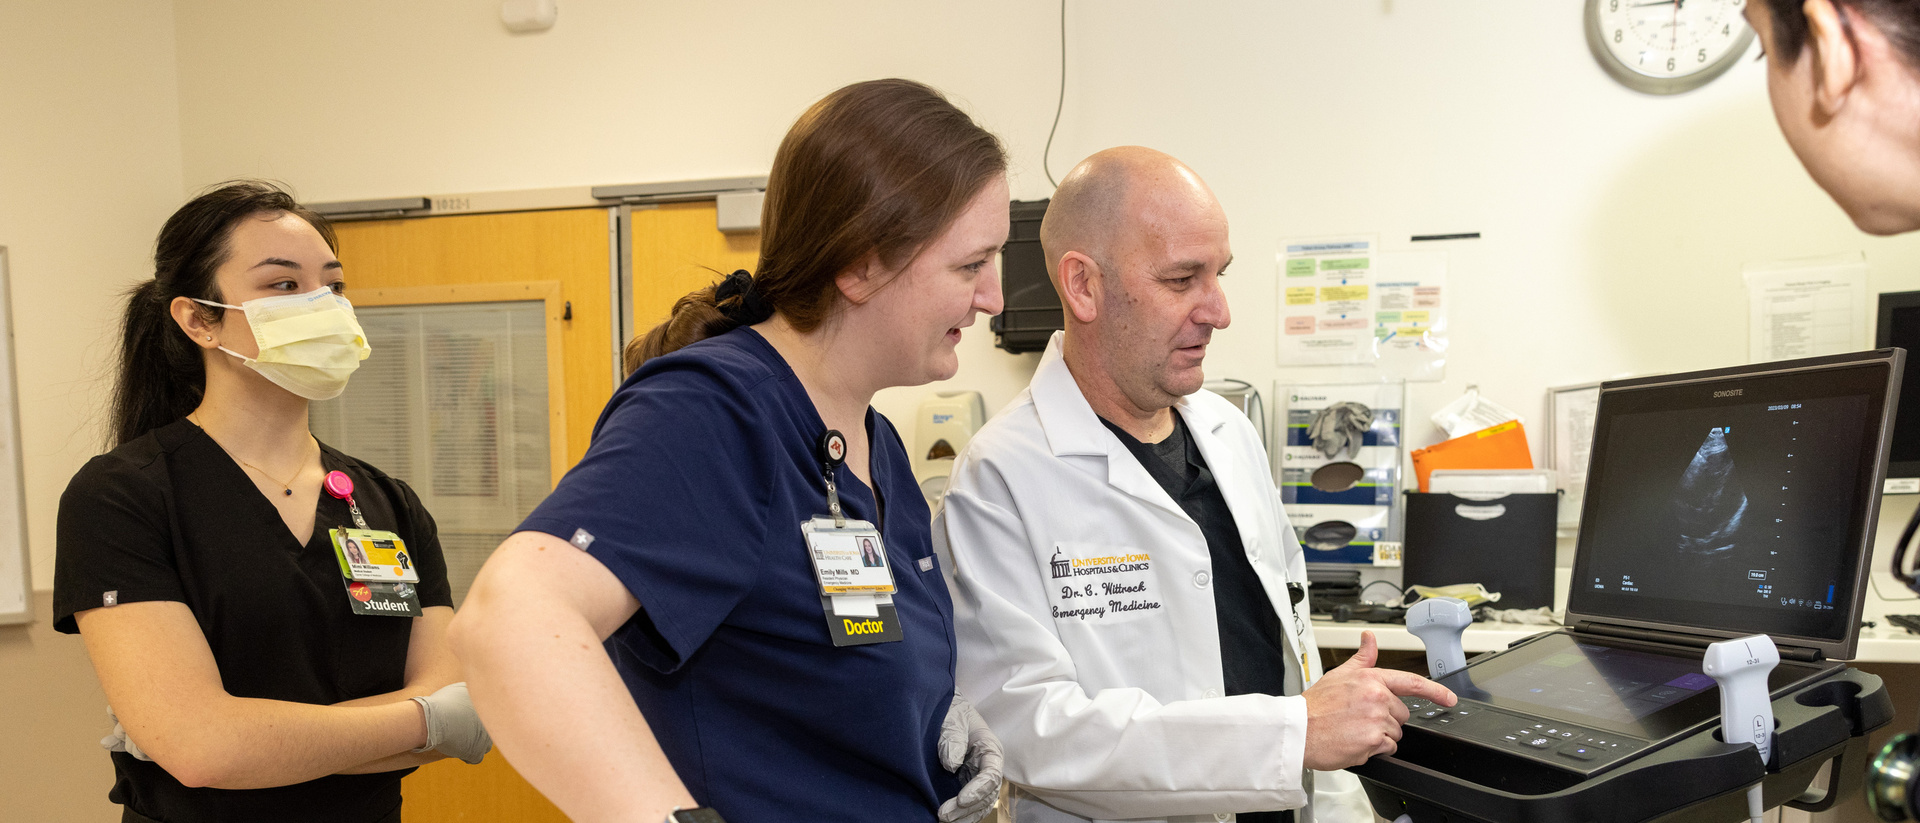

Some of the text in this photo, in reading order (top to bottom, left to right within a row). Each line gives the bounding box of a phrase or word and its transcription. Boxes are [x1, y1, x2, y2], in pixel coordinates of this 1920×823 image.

[1614, 29, 1623, 43] 8
[1697, 49, 1706, 62] 5
[1666, 58, 1675, 71] 6
[1713, 389, 1743, 398] SONOSITE
[1072, 556, 1117, 567] UNIVERSITY
[1125, 554, 1151, 563] IOWA
[820, 569, 836, 577] Emily
[1061, 586, 1083, 599] Dr.
[1102, 581, 1146, 595] Wittrock
[364, 599, 410, 612] Student
[1052, 600, 1161, 620] Emergency Medicine
[843, 619, 884, 636] Doctor
[1756, 720, 1762, 728] L
